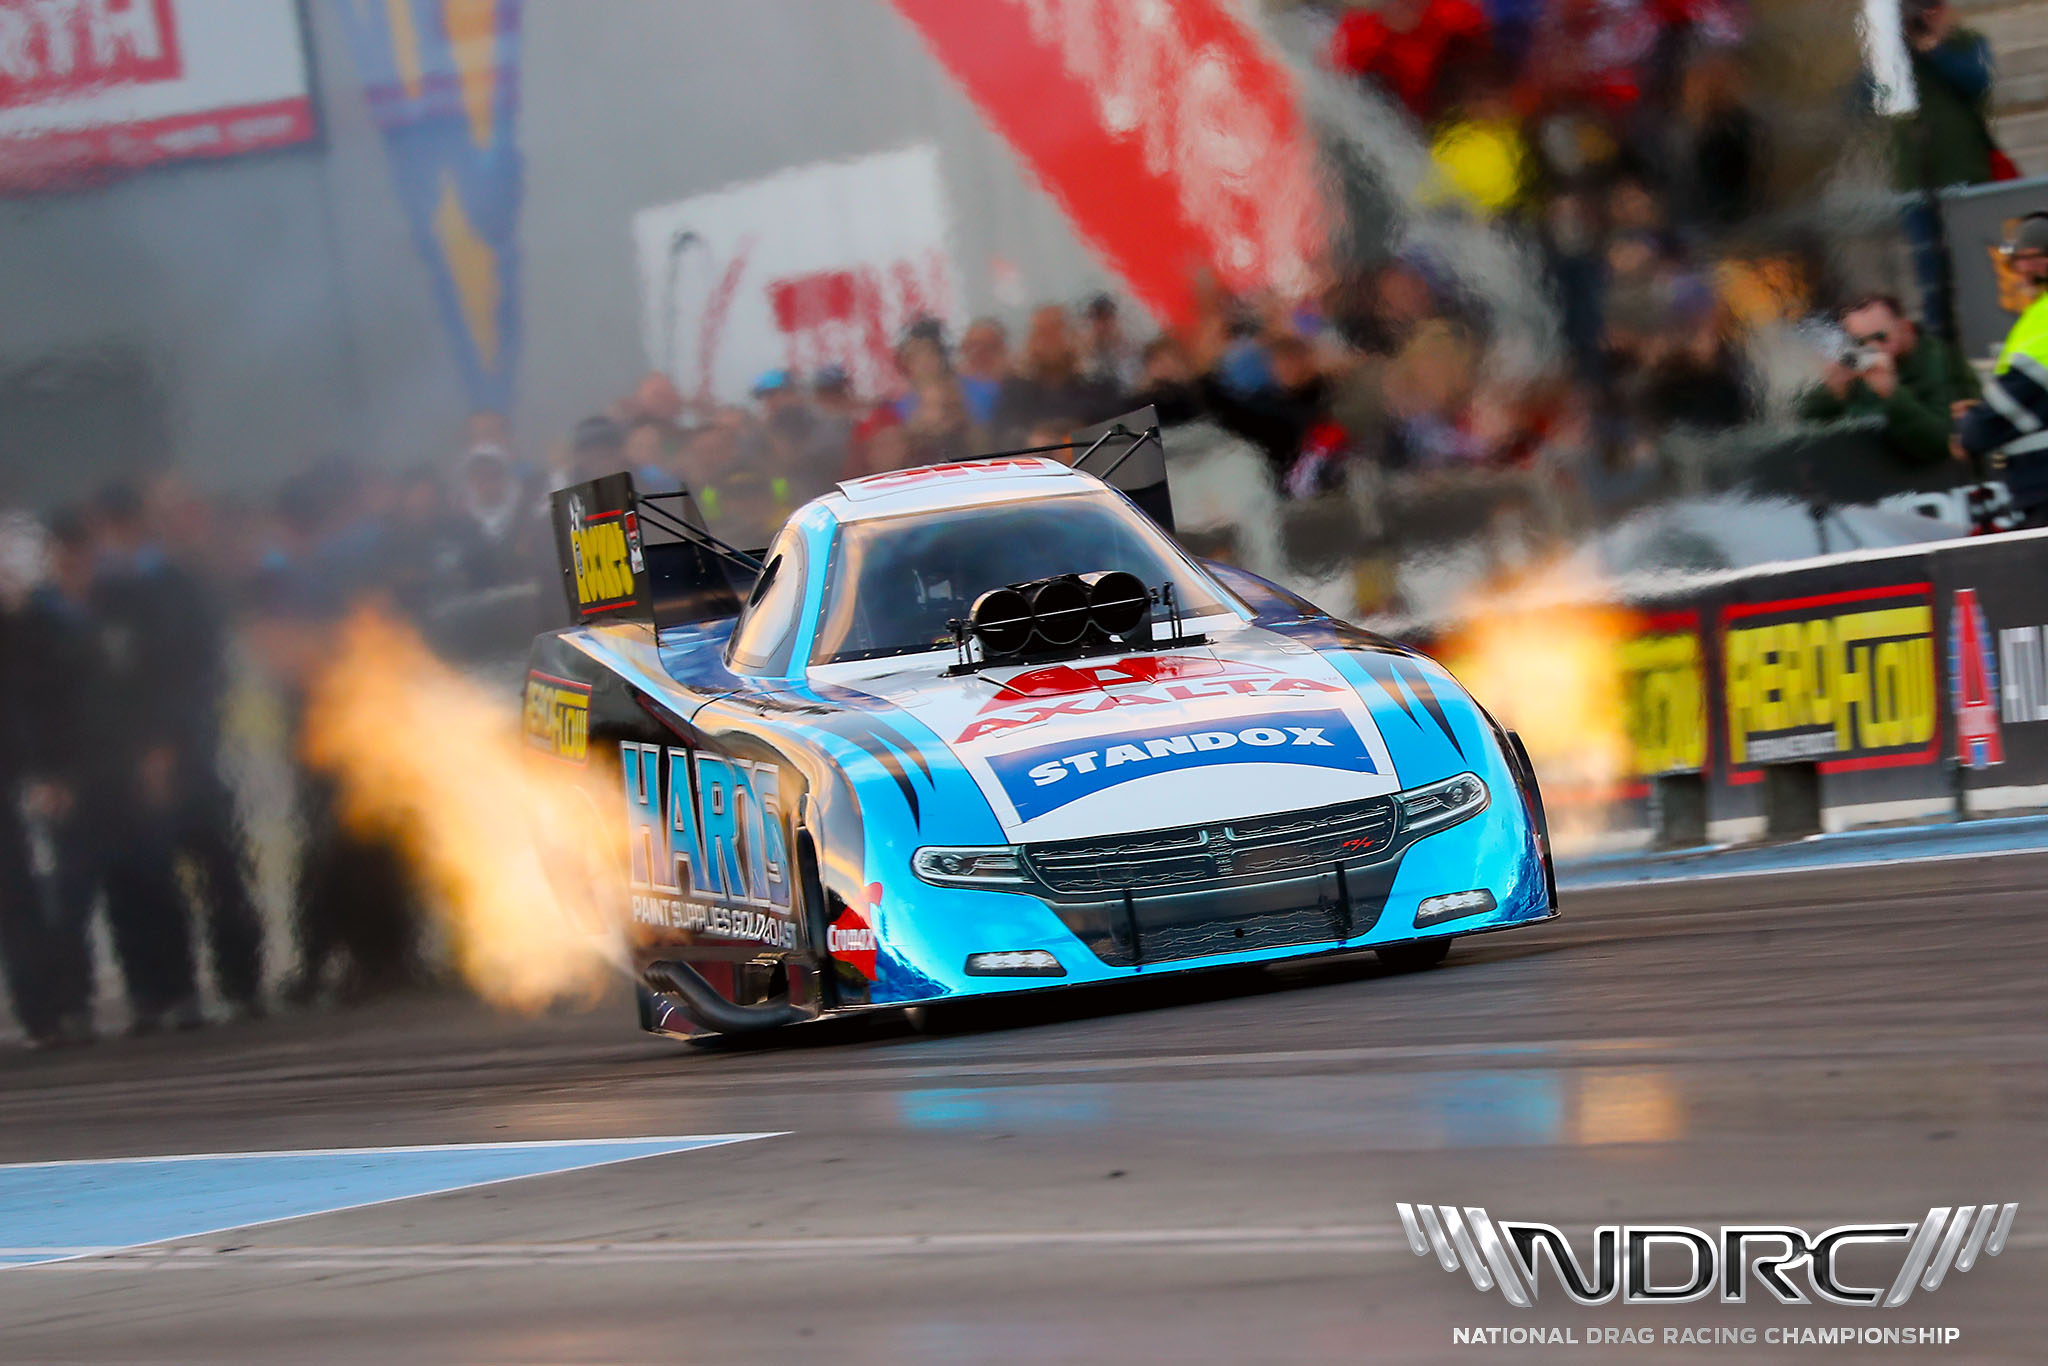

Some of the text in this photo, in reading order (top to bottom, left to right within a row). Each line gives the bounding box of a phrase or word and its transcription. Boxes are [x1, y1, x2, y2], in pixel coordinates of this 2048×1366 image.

[953, 677, 1347, 744] AXALTA
[1726, 605, 1933, 764] AEROFLOW
[1028, 726, 1336, 787] STANDOX
[632, 896, 671, 926] PAINT
[671, 901, 732, 936] SUPPLIES
[732, 907, 766, 941] GOLD
